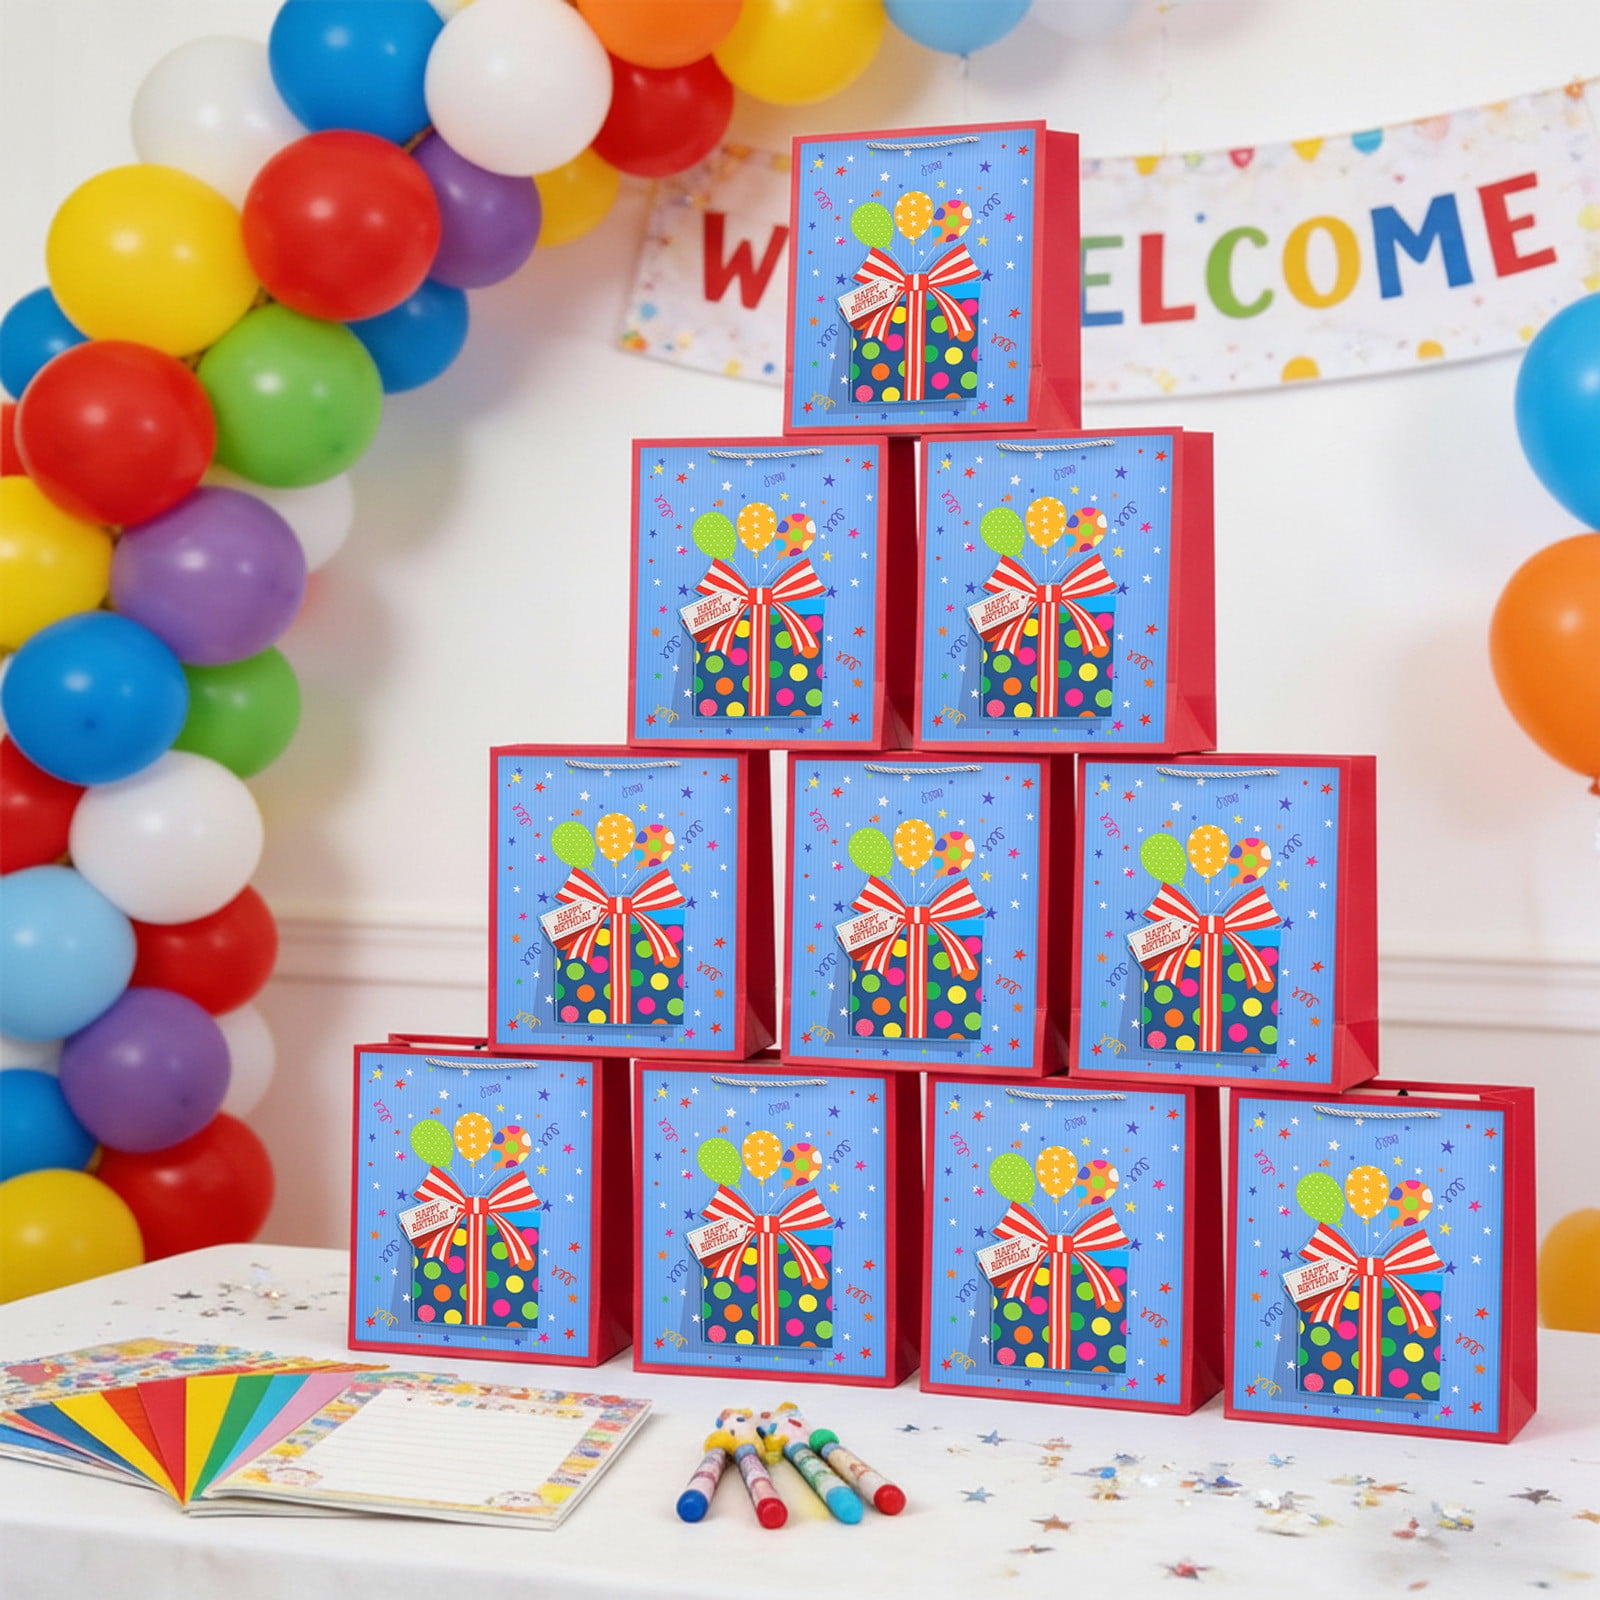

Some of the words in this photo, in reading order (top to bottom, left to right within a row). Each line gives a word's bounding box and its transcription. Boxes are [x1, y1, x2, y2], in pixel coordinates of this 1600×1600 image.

[851, 289, 889, 316] BIRTHDAY
[854, 283, 881, 301] HAPPY
[693, 602, 732, 627] BIRTHDAY
[697, 595, 723, 616] HAPPY
[981, 600, 1021, 626] BIRTHDAY
[984, 593, 1011, 614] HAPPY
[553, 910, 592, 935] BIRTHDAY
[557, 904, 583, 924] HAPPY
[853, 913, 880, 932] HAPPY
[849, 920, 889, 946] BIRTHDAY
[1141, 929, 1182, 955] BIRTHDAY
[1145, 922, 1173, 941] HAPPY
[412, 1209, 450, 1233] BIRTHDAY
[415, 1203, 441, 1222] HAPPY
[700, 1228, 739, 1252] BIRTHDAY
[703, 1221, 730, 1242] HAPPY
[991, 1248, 1030, 1272] BIRTHDAY
[994, 1240, 1022, 1260] HAPPY
[1297, 1270, 1340, 1296] BIRTHDAY
[1301, 1263, 1330, 1283] HAPPY
